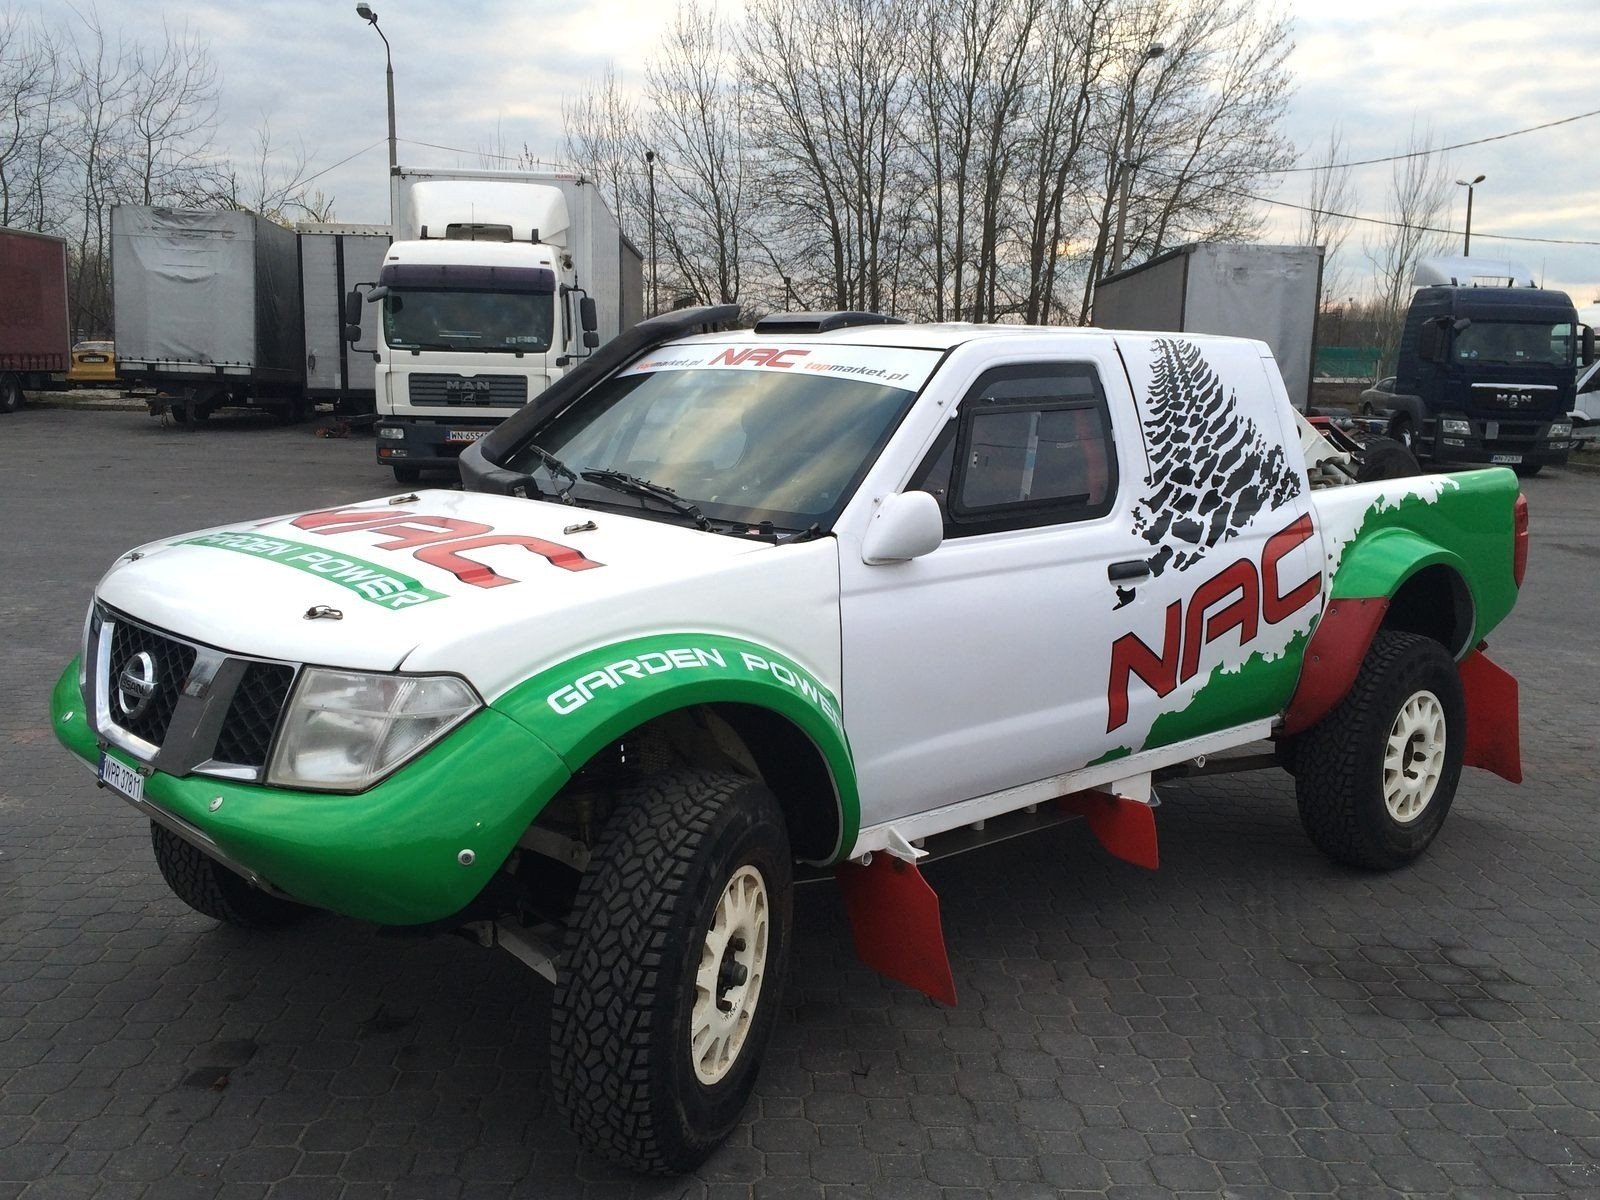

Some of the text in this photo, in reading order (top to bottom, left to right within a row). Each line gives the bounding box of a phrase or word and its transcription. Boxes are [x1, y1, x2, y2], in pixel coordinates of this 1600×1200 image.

[707, 348, 812, 368] NAC
[804, 361, 909, 381] topmarket.pl
[447, 381, 490, 390] MAN
[1496, 394, 1532, 402] MAN
[451, 431, 464, 440] WN
[285, 551, 430, 608] POWER
[1106, 511, 1322, 734] NAC
[547, 648, 727, 715] GARDEN
[104, 757, 141, 799] WPR 37811
